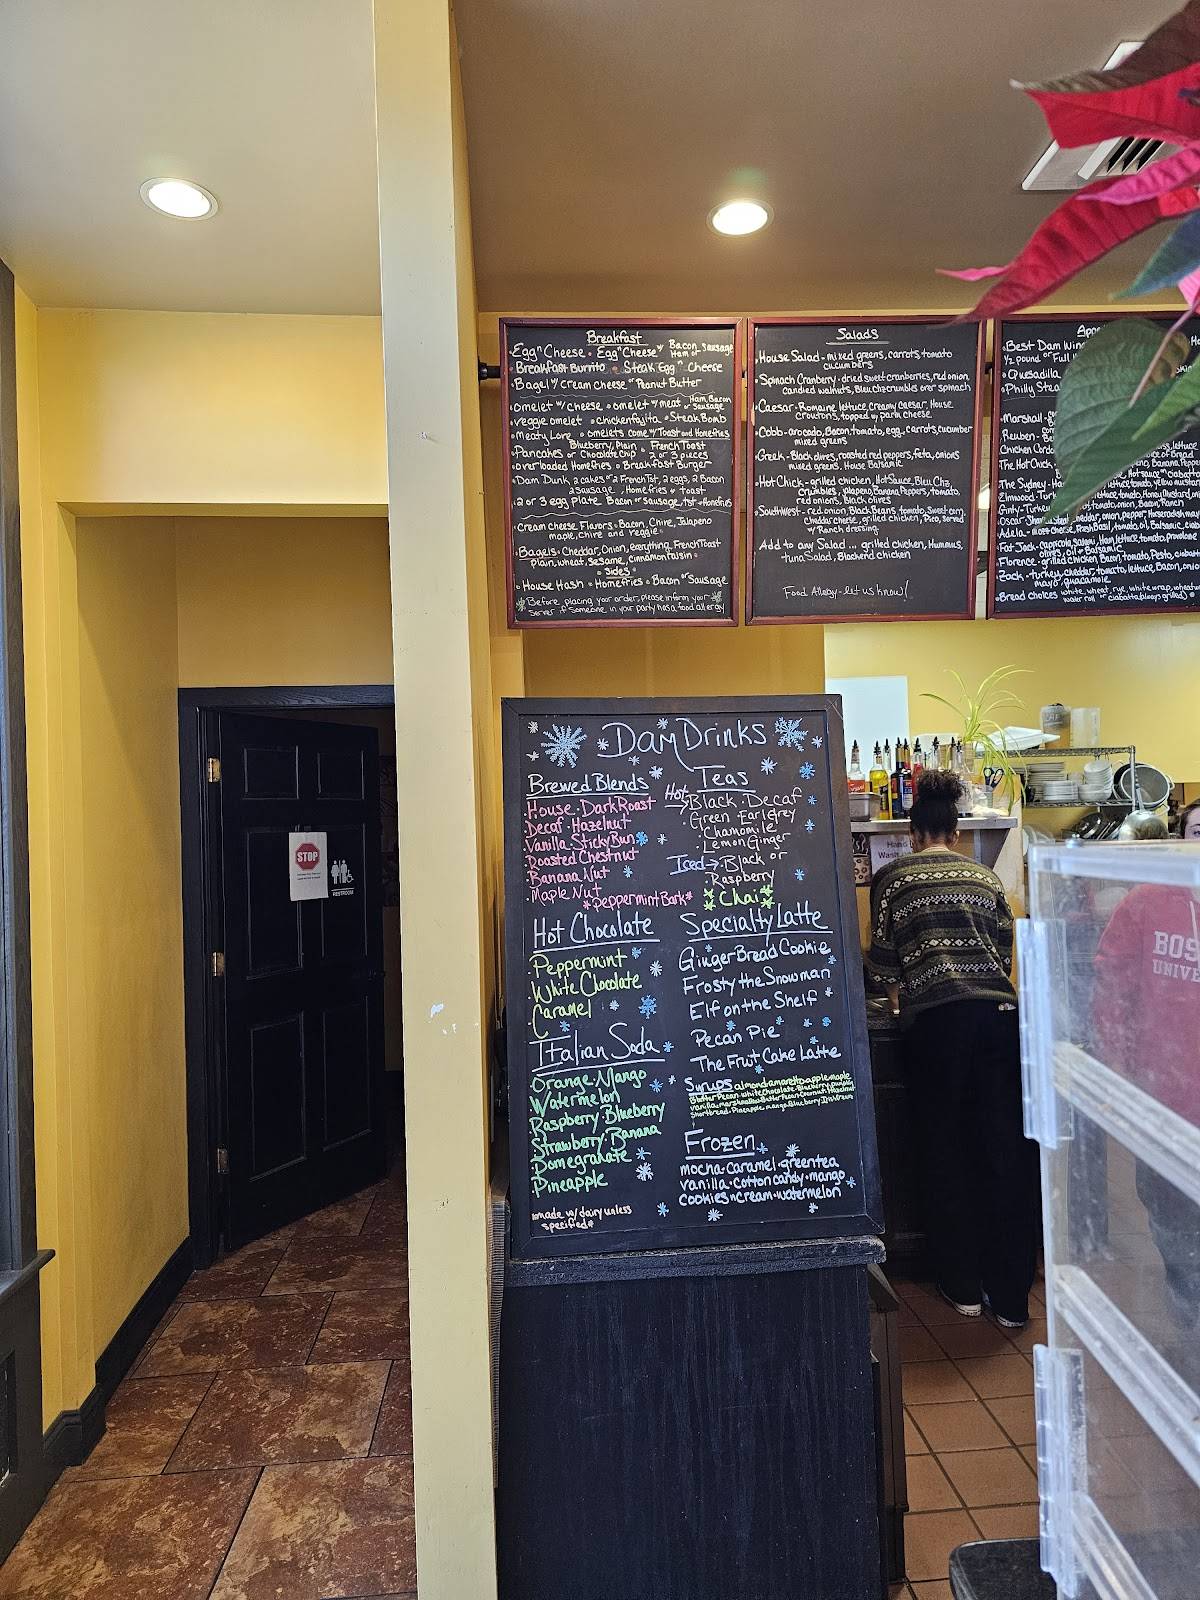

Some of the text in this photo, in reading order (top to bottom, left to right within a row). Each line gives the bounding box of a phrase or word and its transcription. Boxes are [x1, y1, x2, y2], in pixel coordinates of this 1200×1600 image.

[587, 330, 643, 344] Breakfast
[836, 328, 879, 340] Salads
[512, 343, 657, 361] Egg Cheese Egg Cheese
[1006, 340, 1060, 351] Best Dam
[759, 351, 790, 362] House
[791, 350, 820, 362] Salad
[827, 351, 854, 360] mixed
[921, 349, 952, 358] tomato
[516, 362, 724, 375] Breakfast Burrito Steak Egg Cheese
[824, 361, 873, 370] cucumbers
[1008, 369, 1061, 380] Quesadilla
[514, 378, 549, 393] Bagel
[636, 378, 667, 389] Peanut
[669, 378, 702, 387] Butter
[759, 373, 837, 387] Spinach Cranberry
[1005, 384, 1035, 398] Philly
[758, 400, 794, 413] Caesar
[670, 412, 699, 422] Steak
[702, 414, 726, 423] Bomb
[759, 426, 783, 436] Cobb
[758, 449, 785, 462] Greek
[759, 475, 804, 487] Hot Chick
[1000, 478, 1046, 491] The Sydney
[759, 538, 890, 551] Add to any Salad grilled
[523, 580, 554, 591] House
[556, 580, 584, 589] Hash
[652, 576, 680, 585] Bacon
[688, 575, 728, 586] Sausage
[783, 586, 808, 599] Food
[863, 587, 874, 595] us
[1000, 593, 1025, 601] Bread
[598, 718, 767, 763] Dam Drinks
[527, 773, 649, 795] Brewed Blends
[694, 765, 749, 788] Teas
[665, 784, 802, 810] Hot Black Decaf
[527, 797, 656, 818] House Dark Roast
[526, 817, 632, 835] Decaf Hazelnut
[690, 808, 796, 830] Green Earl Grey
[704, 822, 777, 839] Chamomile
[525, 832, 636, 853] Vanilla Sticky Bun
[703, 832, 790, 853] Lemon Ginger
[297, 852, 318, 862] STOP
[527, 849, 639, 869] Roasted Chestnut
[667, 854, 705, 875] Iced
[722, 856, 765, 872] Black
[529, 866, 610, 886] Banana Nut
[709, 871, 775, 888] Raspberry
[530, 886, 602, 903] Maple Nut
[719, 888, 759, 906] Chai
[533, 911, 653, 948] Hot Chocolate
[680, 901, 828, 945] Specialty Latte
[779, 938, 830, 955] Cookie
[529, 948, 627, 978] Peppermint
[1152, 959, 1200, 983] UNIVE
[532, 970, 642, 1004] White Chocolate
[682, 966, 830, 996] Frosty the Snowman
[690, 991, 818, 1020] Elf on the Shelf
[532, 999, 592, 1039] Caramel
[691, 1024, 781, 1048] Pecan Pie
[530, 1023, 660, 1072] Italian Soda
[690, 1044, 841, 1073] The Fruit Cake Latte
[530, 1068, 647, 1092] Orange Mango
[684, 1079, 733, 1095] Syrups
[530, 1090, 621, 1116] Watermelon
[530, 1103, 665, 1137] Raspberry Blueberry
[531, 1124, 661, 1158] Strawberry Banana
[684, 1129, 754, 1154] Frozen
[531, 1150, 632, 1176] Pomegranate
[532, 1171, 608, 1197] Pineapple
[809, 1169, 845, 1183] mango
[776, 1187, 841, 1202] watermelon
[604, 1206, 632, 1216] unless
